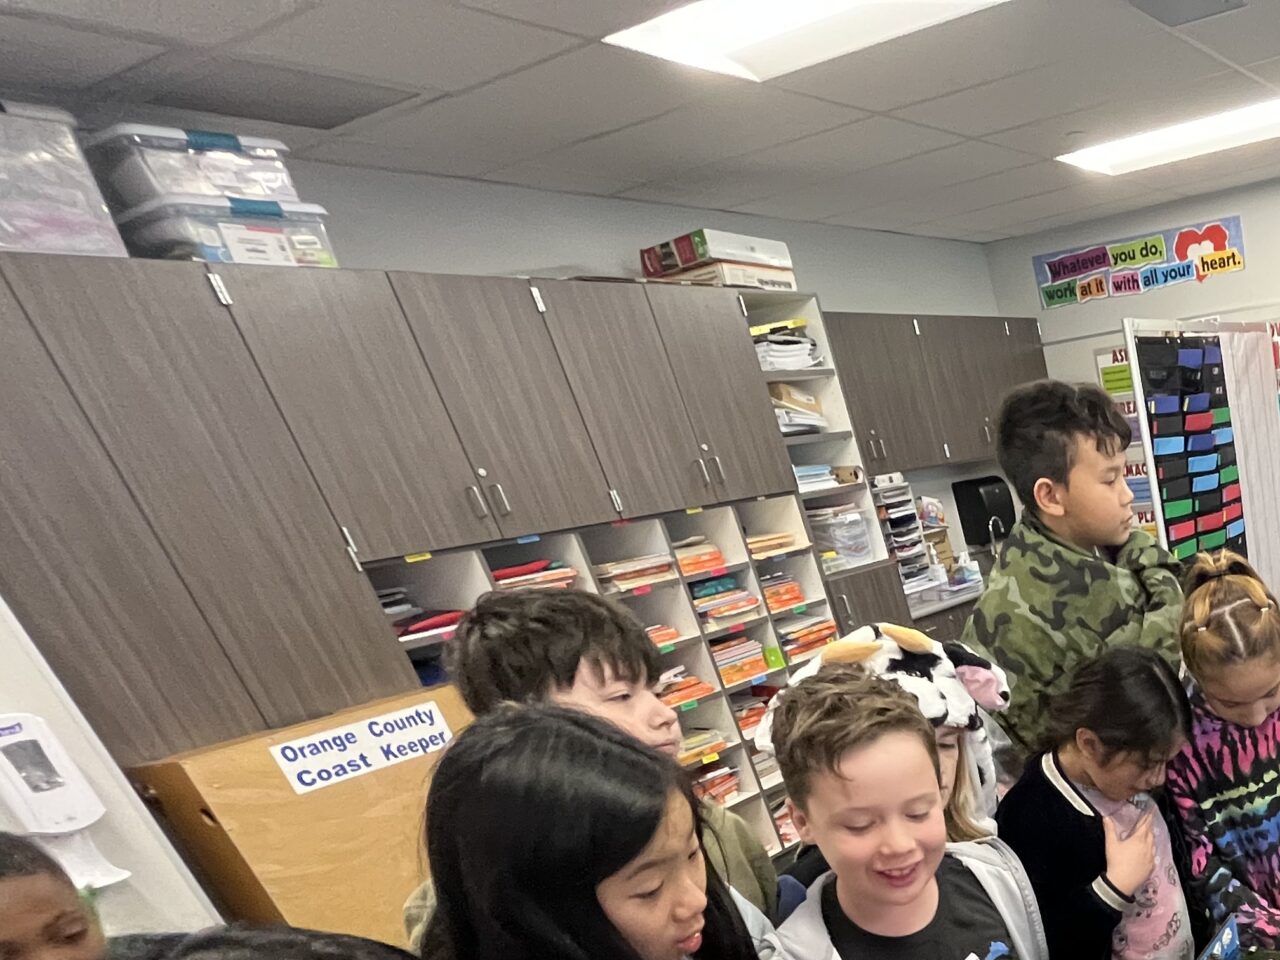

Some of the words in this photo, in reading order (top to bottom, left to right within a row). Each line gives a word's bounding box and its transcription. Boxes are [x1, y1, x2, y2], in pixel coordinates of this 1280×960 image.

[1045, 284, 1077, 300] work
[1080, 284, 1092, 297] at
[1096, 279, 1104, 293] it
[1112, 275, 1139, 292] with
[1143, 270, 1159, 287] all
[1162, 264, 1192, 283] your
[1201, 252, 1241, 273] heart.
[1050, 252, 1108, 279] Whatever
[1112, 250, 1135, 265] you
[1140, 241, 1163, 258] do,
[281, 732, 358, 762] Orange
[367, 709, 436, 738] County
[296, 753, 372, 787] Coast
[380, 731, 447, 761] Keeper
